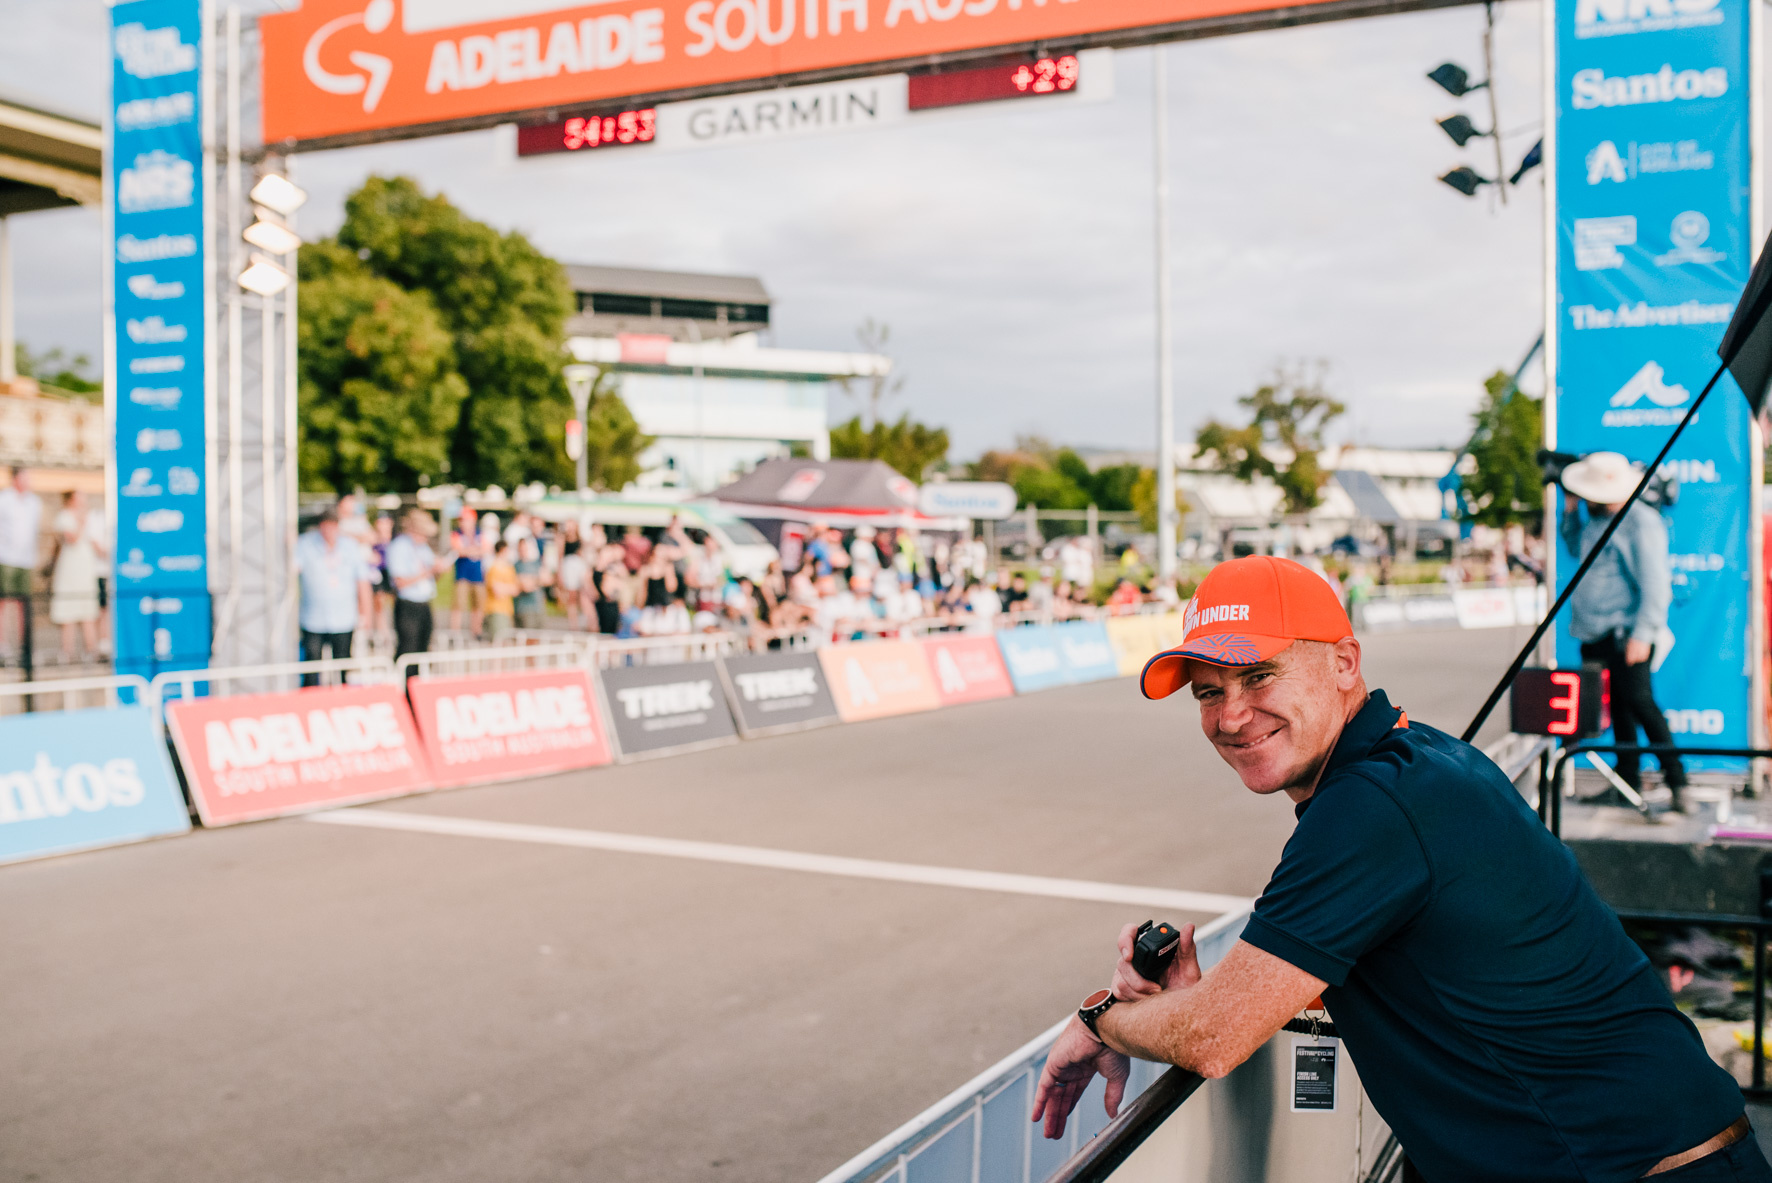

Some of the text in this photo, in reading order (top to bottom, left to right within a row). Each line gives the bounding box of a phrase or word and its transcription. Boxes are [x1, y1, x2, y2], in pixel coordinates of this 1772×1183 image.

[425, 0, 869, 94] ADELAIDE SOUTH
[1571, 63, 1729, 110] Santos
[688, 88, 879, 141] GARMIN
[1569, 304, 1614, 330] The
[1201, 604, 1250, 626] UNDER
[616, 679, 715, 719] TREK
[735, 667, 819, 700] TREK
[1547, 671, 1581, 735] 3
[204, 702, 405, 771] ADELAIDE
[435, 684, 591, 742] ADELAIDE
[440, 728, 595, 766] SOUTH AUSTRALIA
[0, 751, 146, 825] ntos
[213, 750, 413, 797] SOUTH AUSTRALIA
